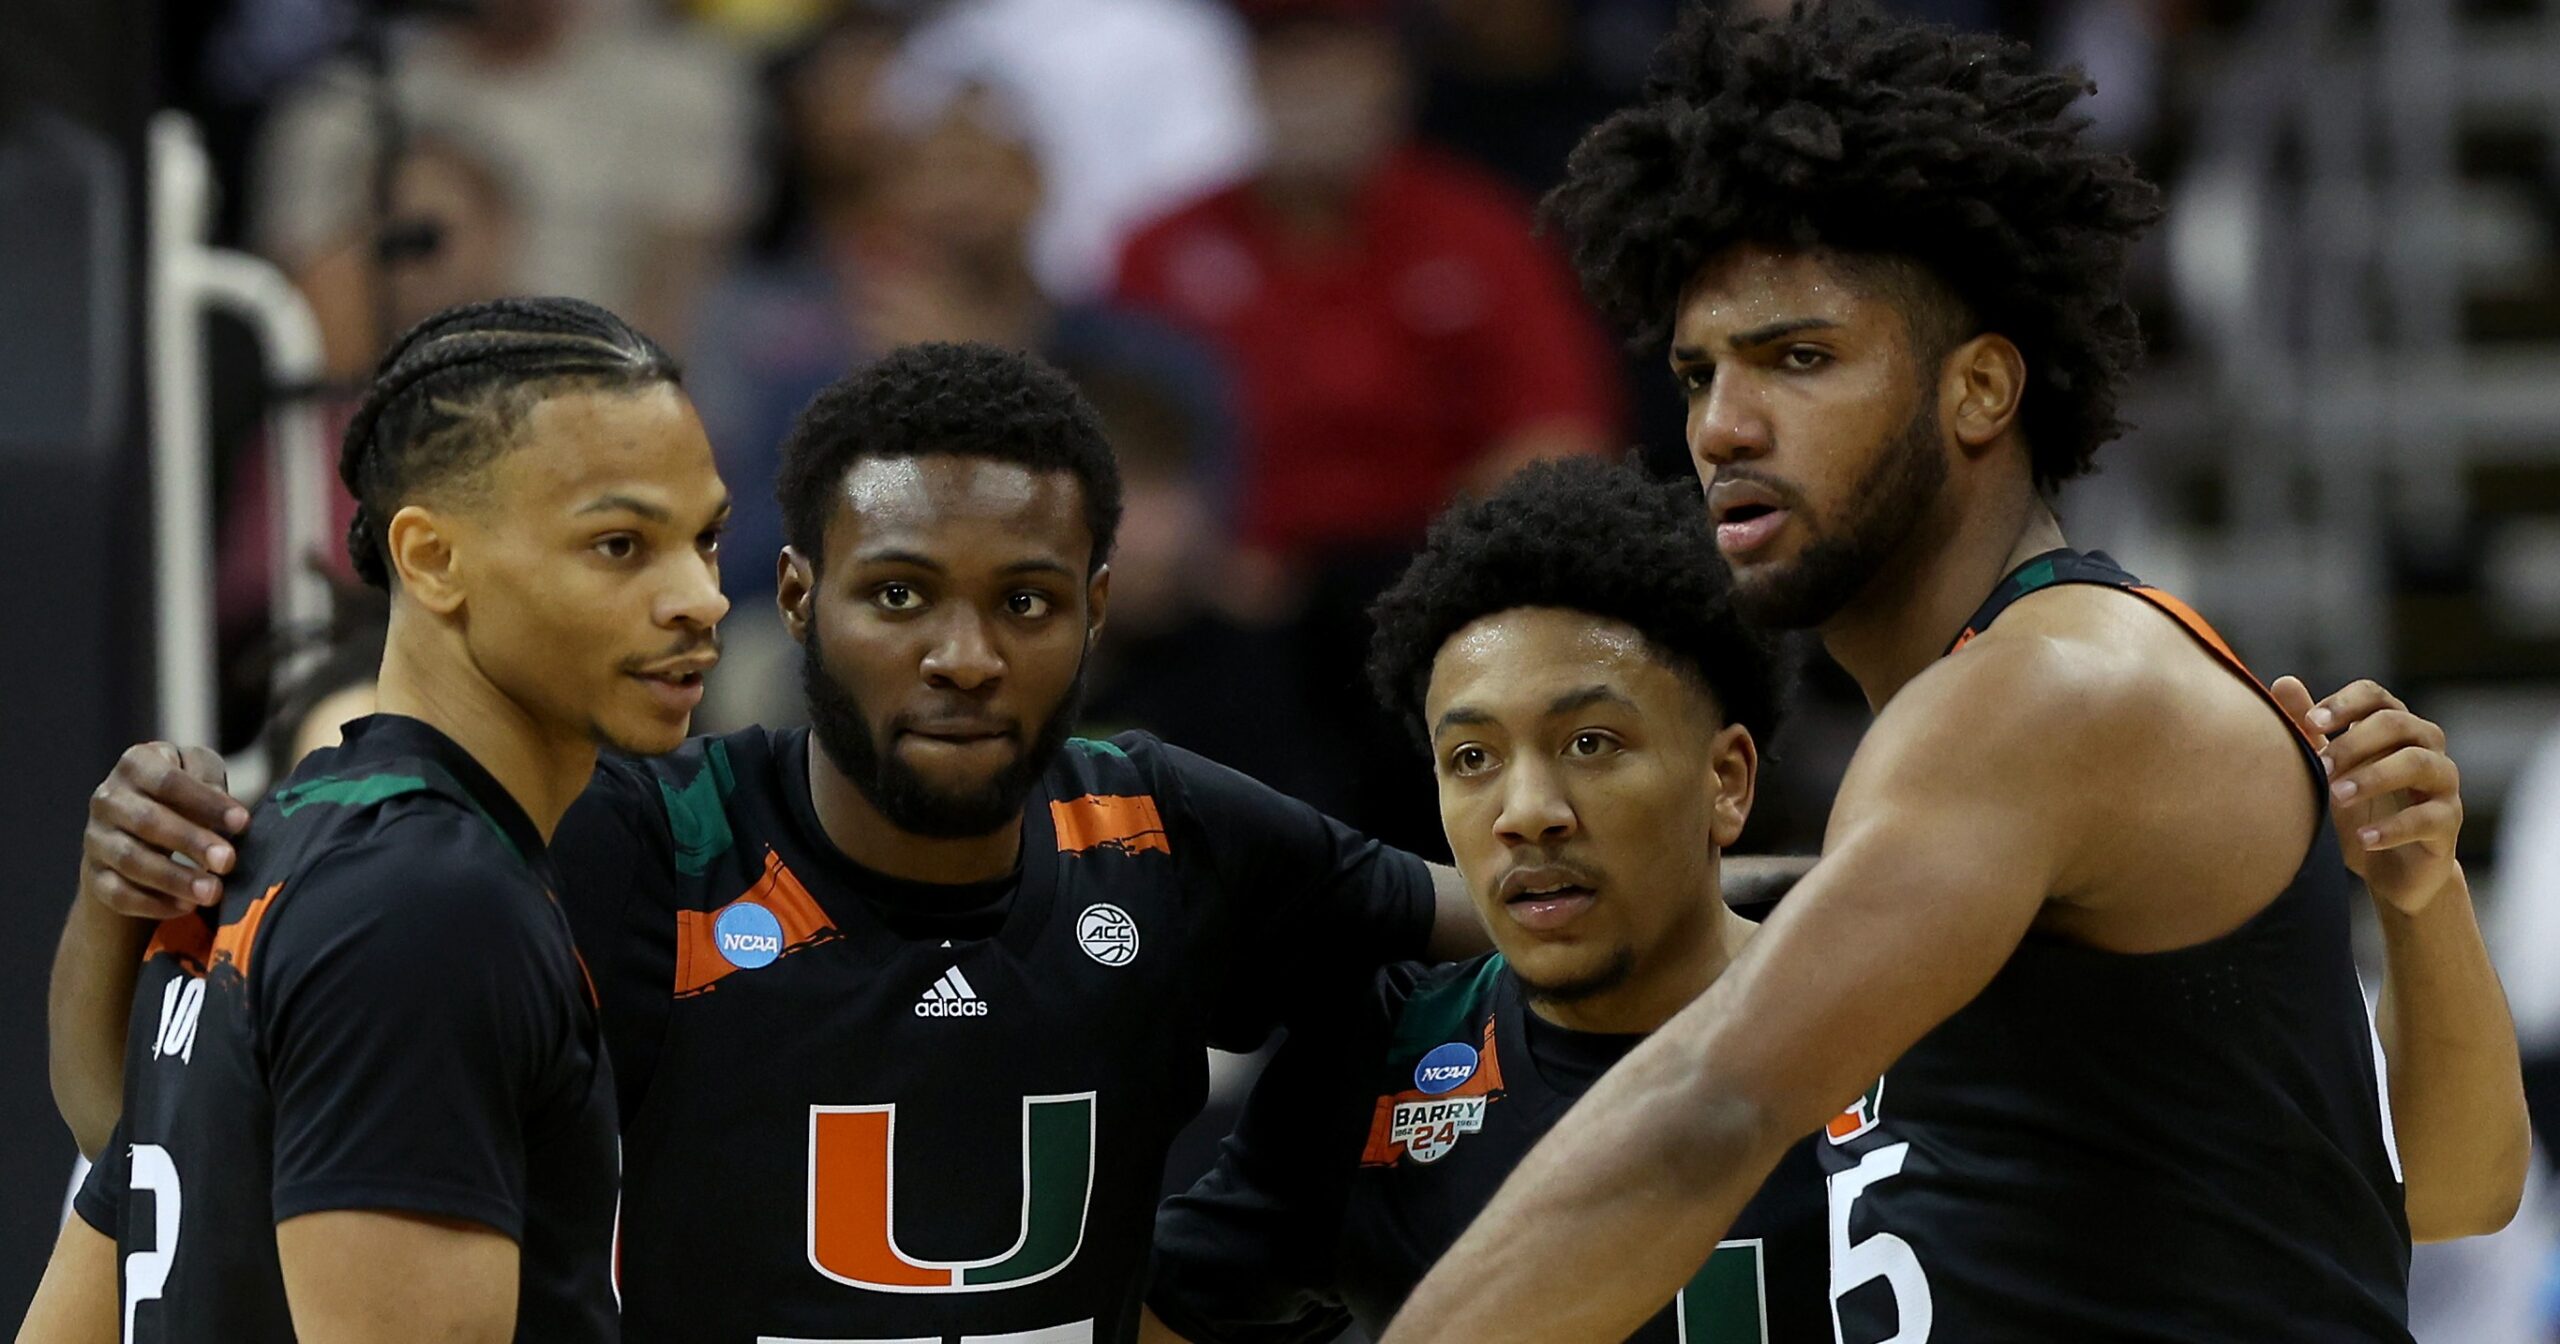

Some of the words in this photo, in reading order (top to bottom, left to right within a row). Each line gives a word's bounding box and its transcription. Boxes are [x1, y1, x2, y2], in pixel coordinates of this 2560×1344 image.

[724, 933, 778, 953] NCAA
[1087, 925, 1132, 939] ACC
[914, 998, 988, 1017] adidas
[1421, 1065, 1472, 1082] NCAA
[1395, 1101, 1484, 1127] BARRY
[1411, 1121, 1456, 1151] 24
[807, 1090, 1097, 1294] U
[1826, 1142, 1933, 1344] 5
